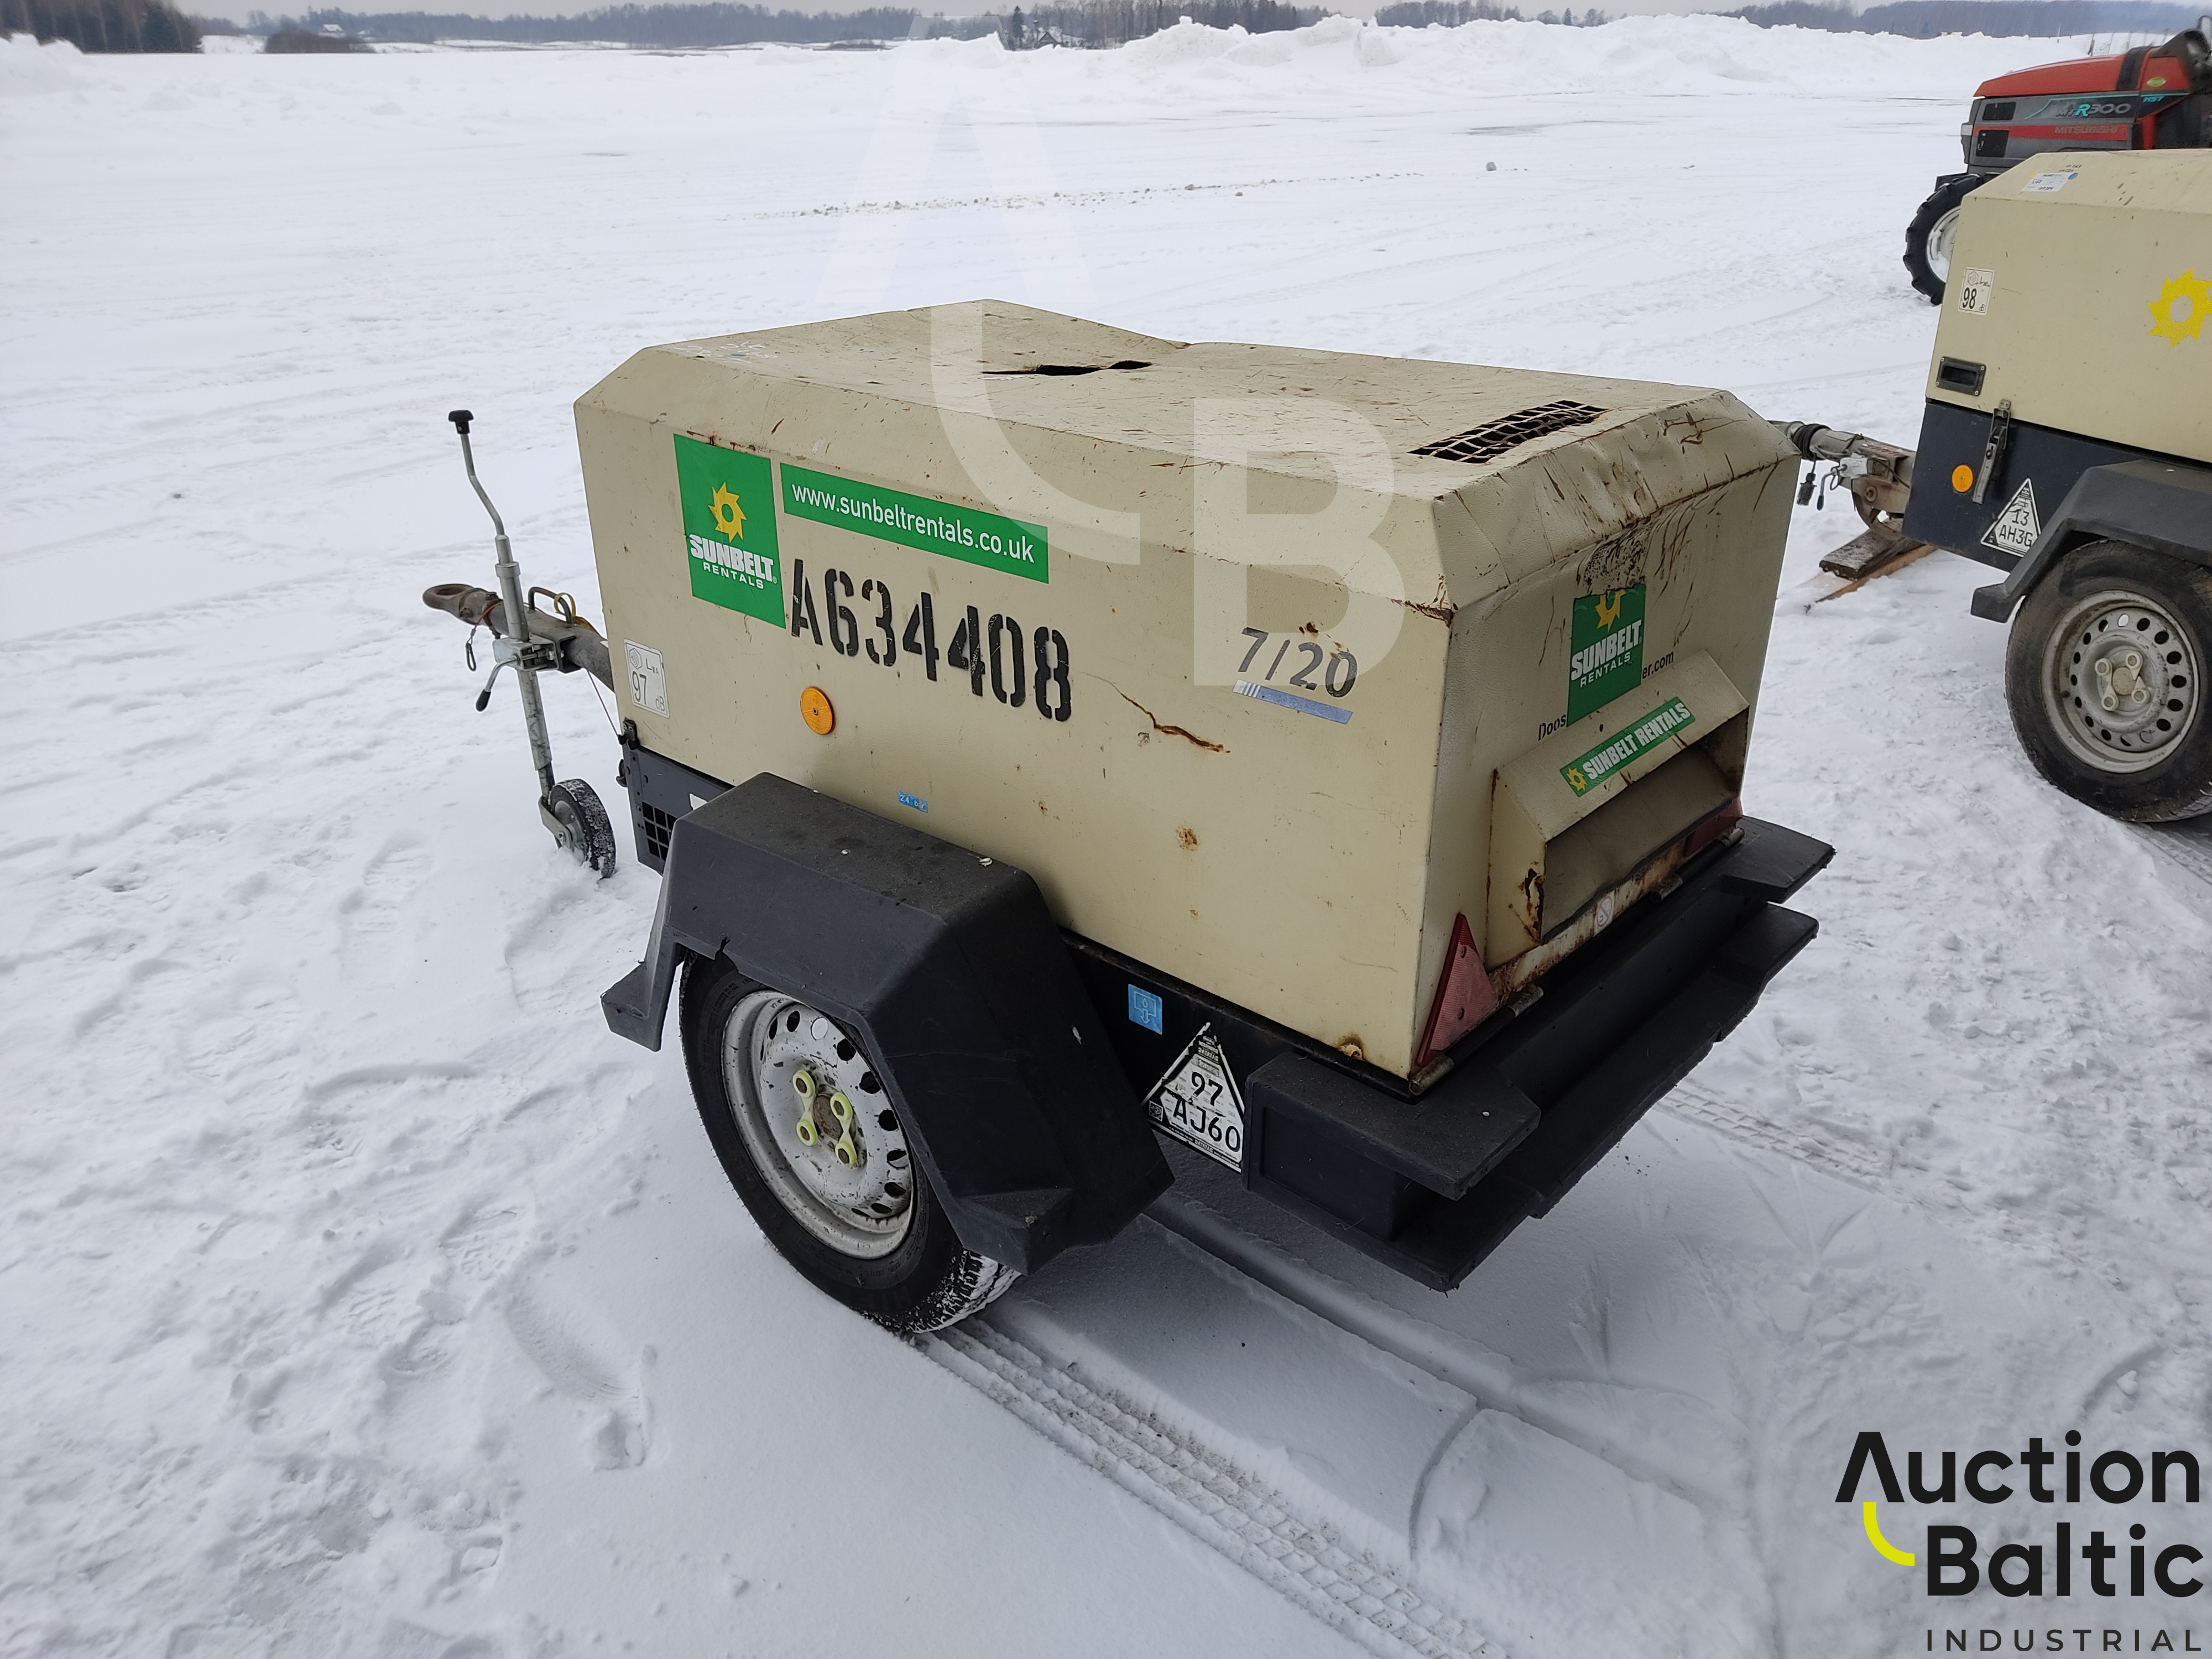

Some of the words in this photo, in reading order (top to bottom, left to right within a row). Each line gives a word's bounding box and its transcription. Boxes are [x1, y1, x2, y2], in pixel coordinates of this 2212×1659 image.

[1963, 287, 1977, 309] 98
[791, 483, 1035, 564] www.sunbeltrentals.co.uk
[1999, 524, 2033, 547] AH3G
[2012, 510, 2030, 526] 13
[689, 534, 774, 583] SUNBELT
[703, 562, 764, 590] RENTALS
[791, 558, 1072, 722] A634408
[1571, 619, 1642, 681] SUNBELT
[1238, 627, 1358, 698] 7/20
[1580, 651, 1631, 688] RENTALS
[632, 671, 647, 705] 97
[655, 695, 666, 712] dB
[1582, 734, 1638, 780] SUNBELT
[1634, 702, 1691, 747] RENTALS
[1191, 1071, 1223, 1107] 97
[1173, 1098, 1241, 1152] AJ60
